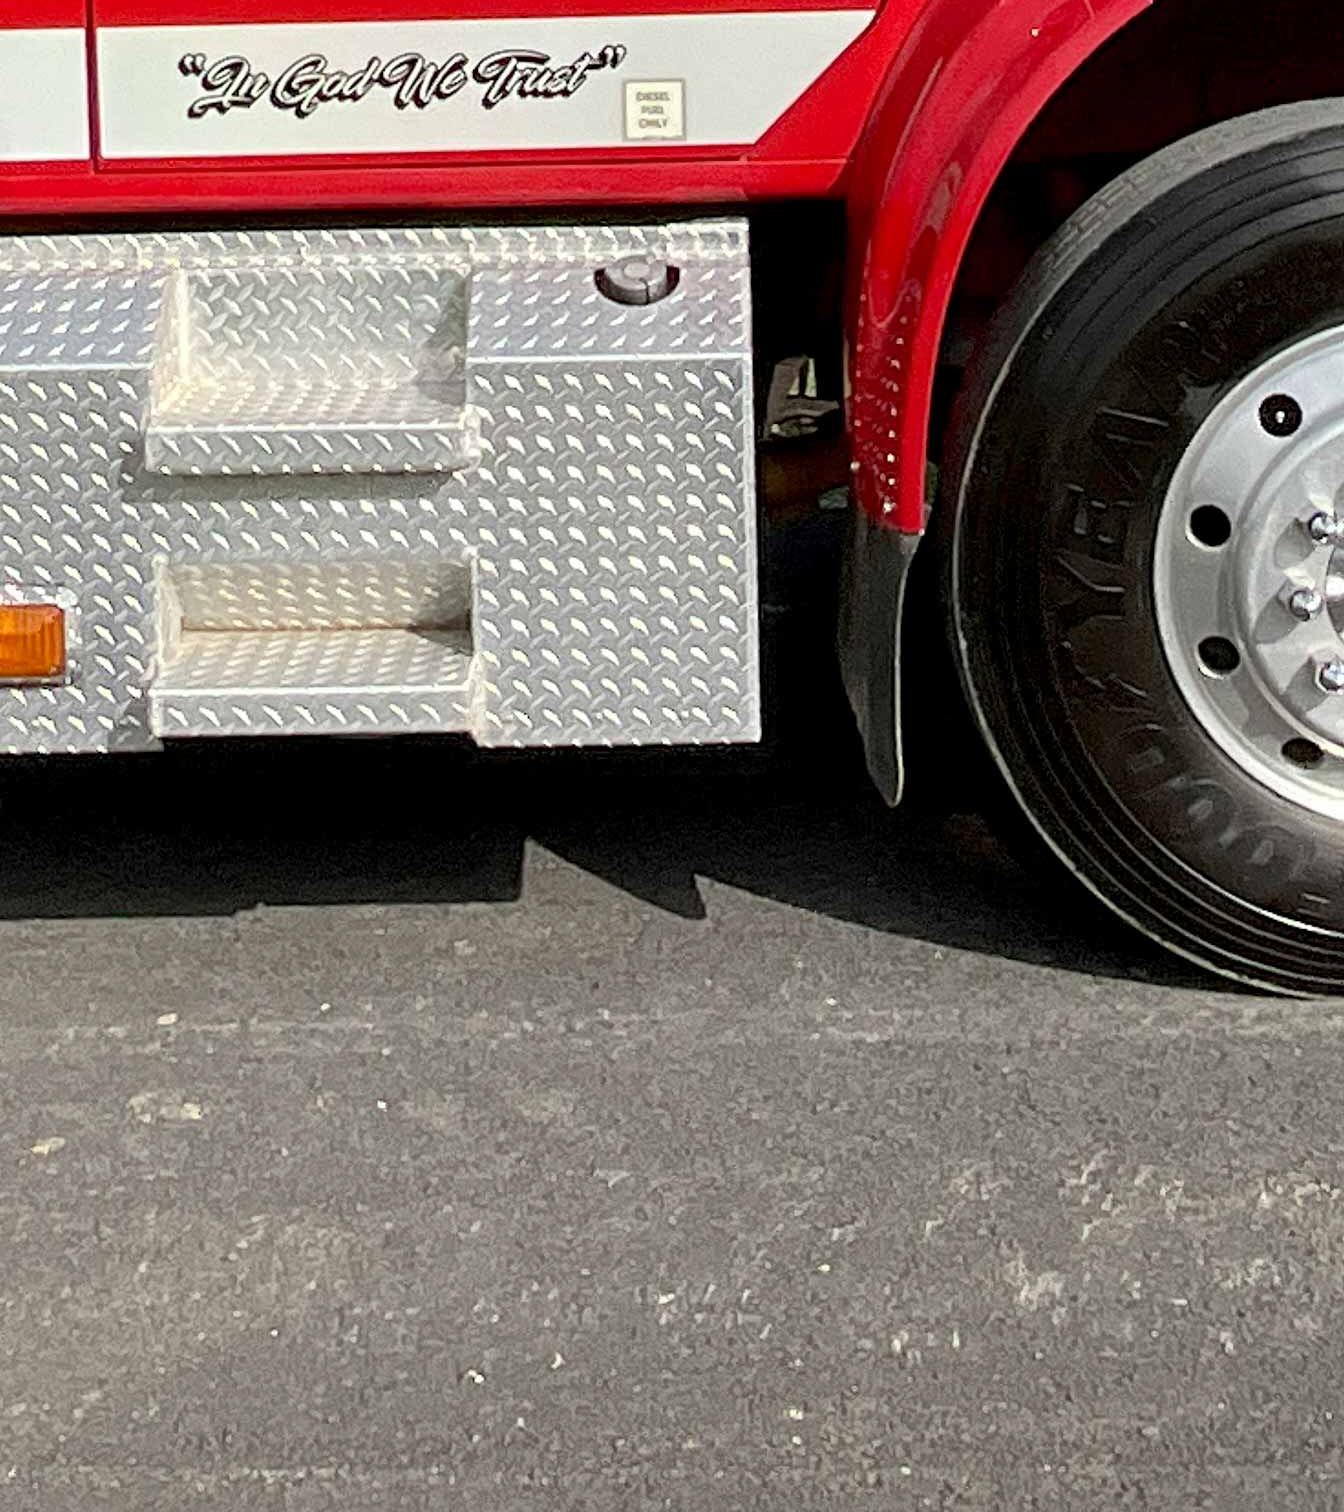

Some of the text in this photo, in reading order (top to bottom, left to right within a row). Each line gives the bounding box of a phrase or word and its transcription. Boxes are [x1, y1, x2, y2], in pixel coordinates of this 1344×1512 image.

[270, 53, 382, 119] God
[378, 52, 468, 110] We
[638, 118, 668, 129] ONLY
